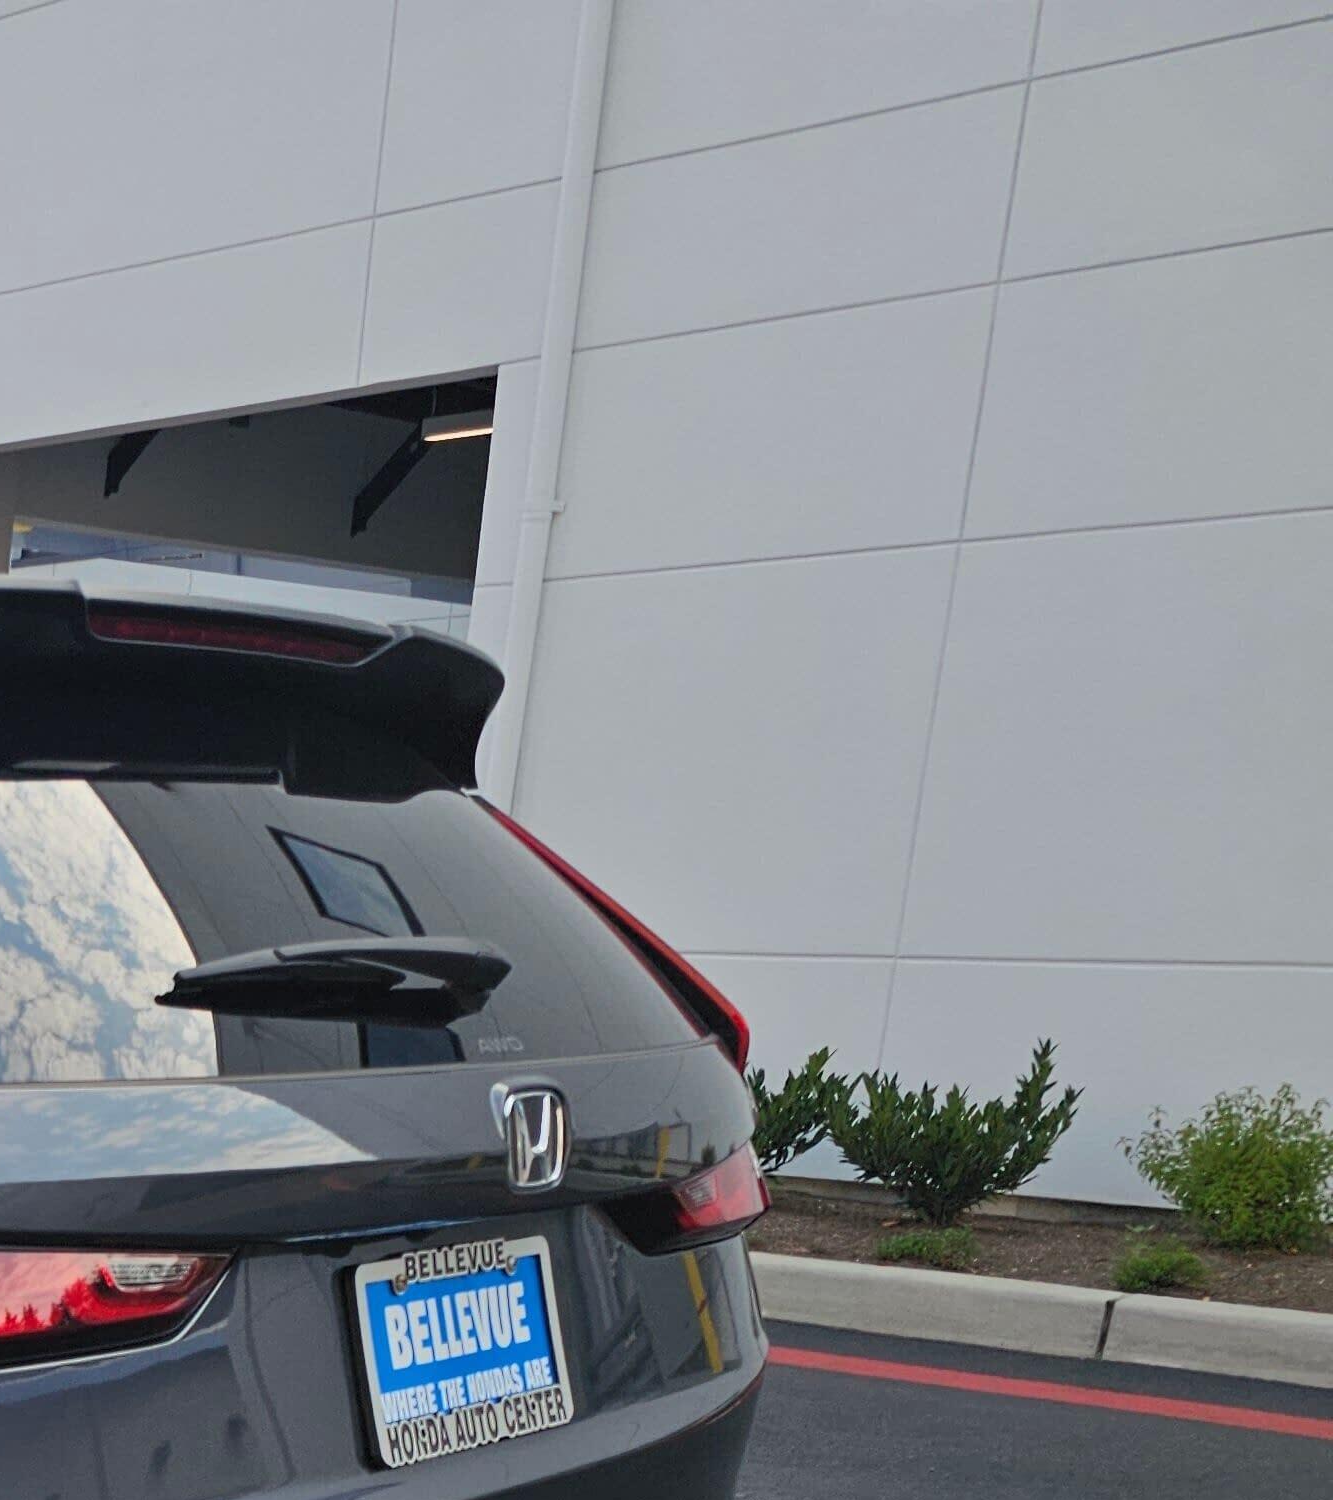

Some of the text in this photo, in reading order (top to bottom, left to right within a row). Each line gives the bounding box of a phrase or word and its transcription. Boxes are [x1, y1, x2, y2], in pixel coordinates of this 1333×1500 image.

[404, 1241, 506, 1279] BELLEVUE
[384, 1282, 531, 1370] BELLEVUE
[381, 1356, 552, 1423] WHERE THE HONDAS ARE
[388, 1387, 567, 1463] HONDA AUTO CENTER
